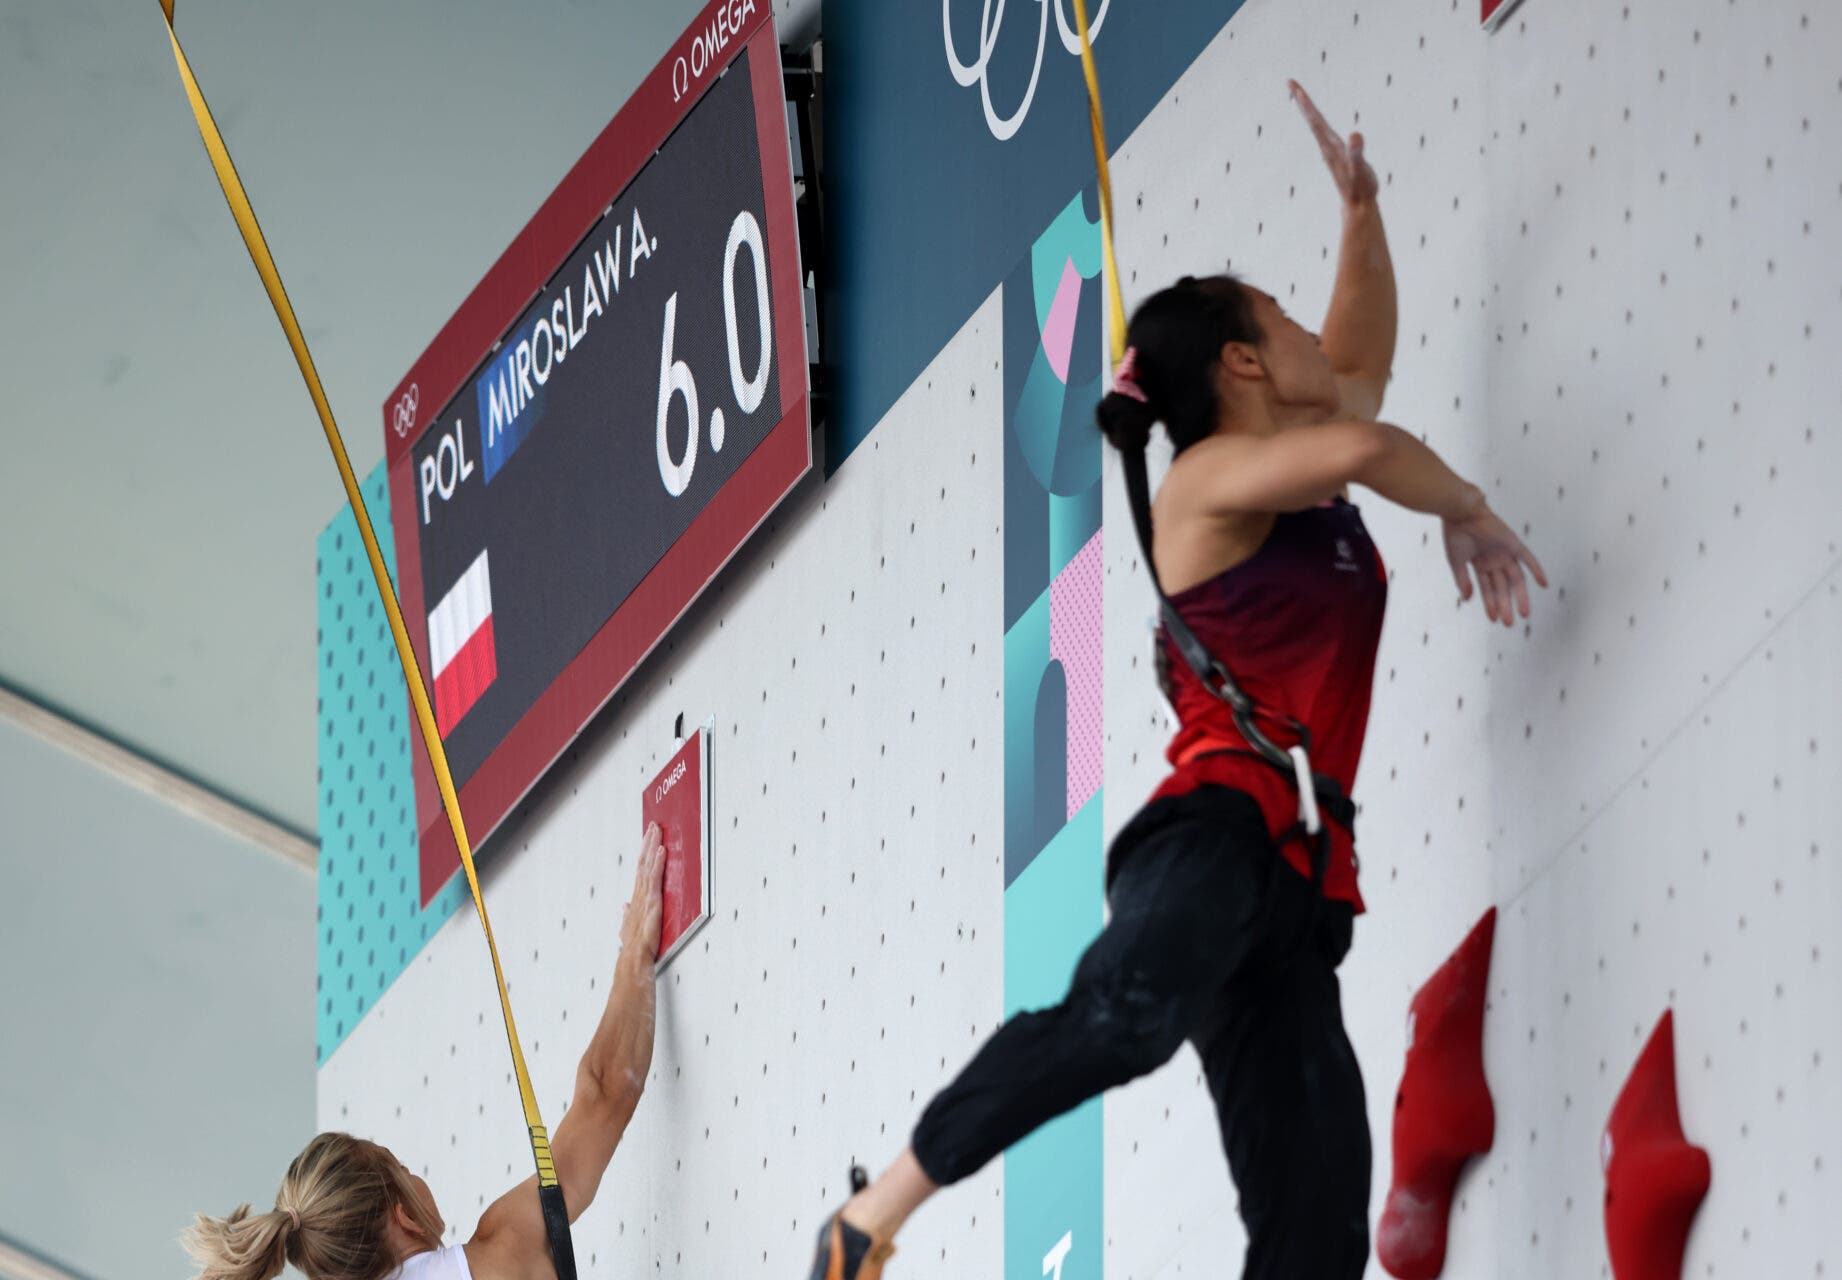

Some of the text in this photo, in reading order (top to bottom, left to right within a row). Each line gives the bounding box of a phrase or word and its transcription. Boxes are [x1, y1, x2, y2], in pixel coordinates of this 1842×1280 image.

[691, 0, 756, 78] OMEGA
[420, 205, 658, 525] POL MIROSLAW A.
[656, 209, 772, 498] 6.0
[662, 758, 687, 795] OMEGA
